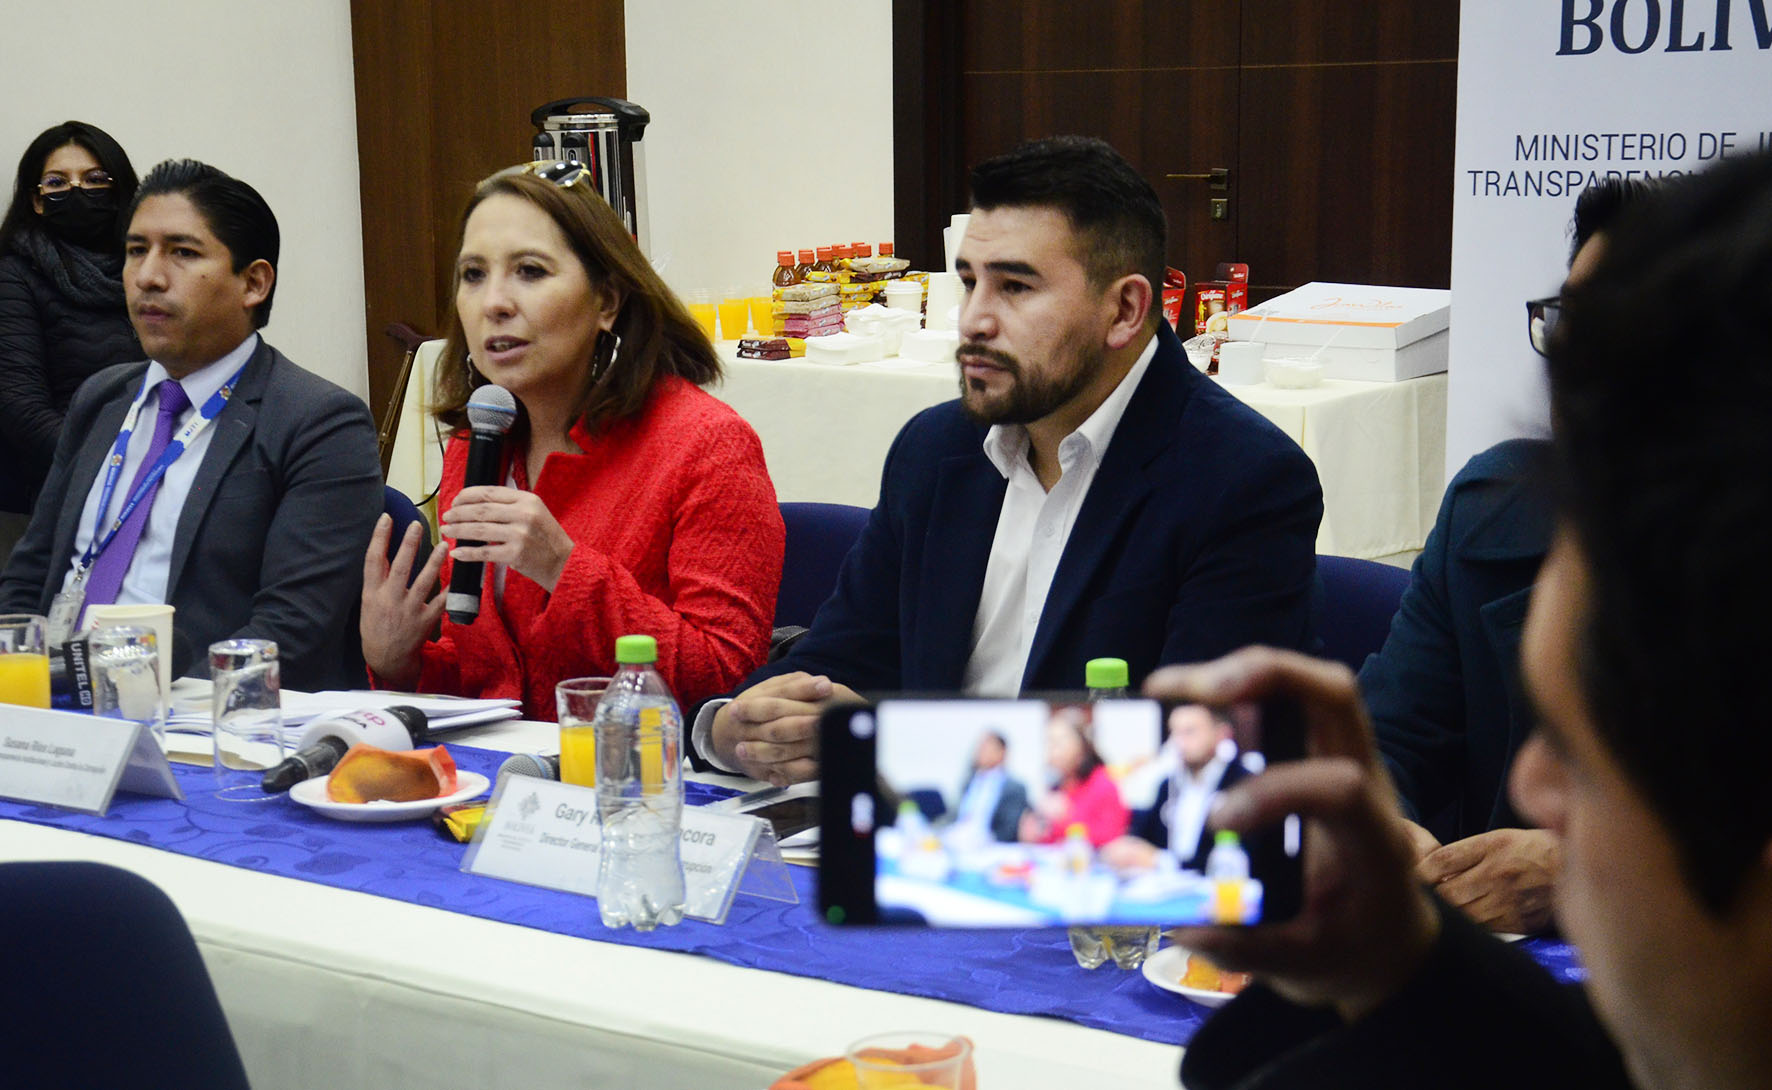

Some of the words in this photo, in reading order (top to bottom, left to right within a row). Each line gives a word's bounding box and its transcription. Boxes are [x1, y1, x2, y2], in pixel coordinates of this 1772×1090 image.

[1515, 133, 1687, 161] MINISTERIO
[71, 641, 88, 690] UNITEL
[555, 803, 589, 827] Gary
